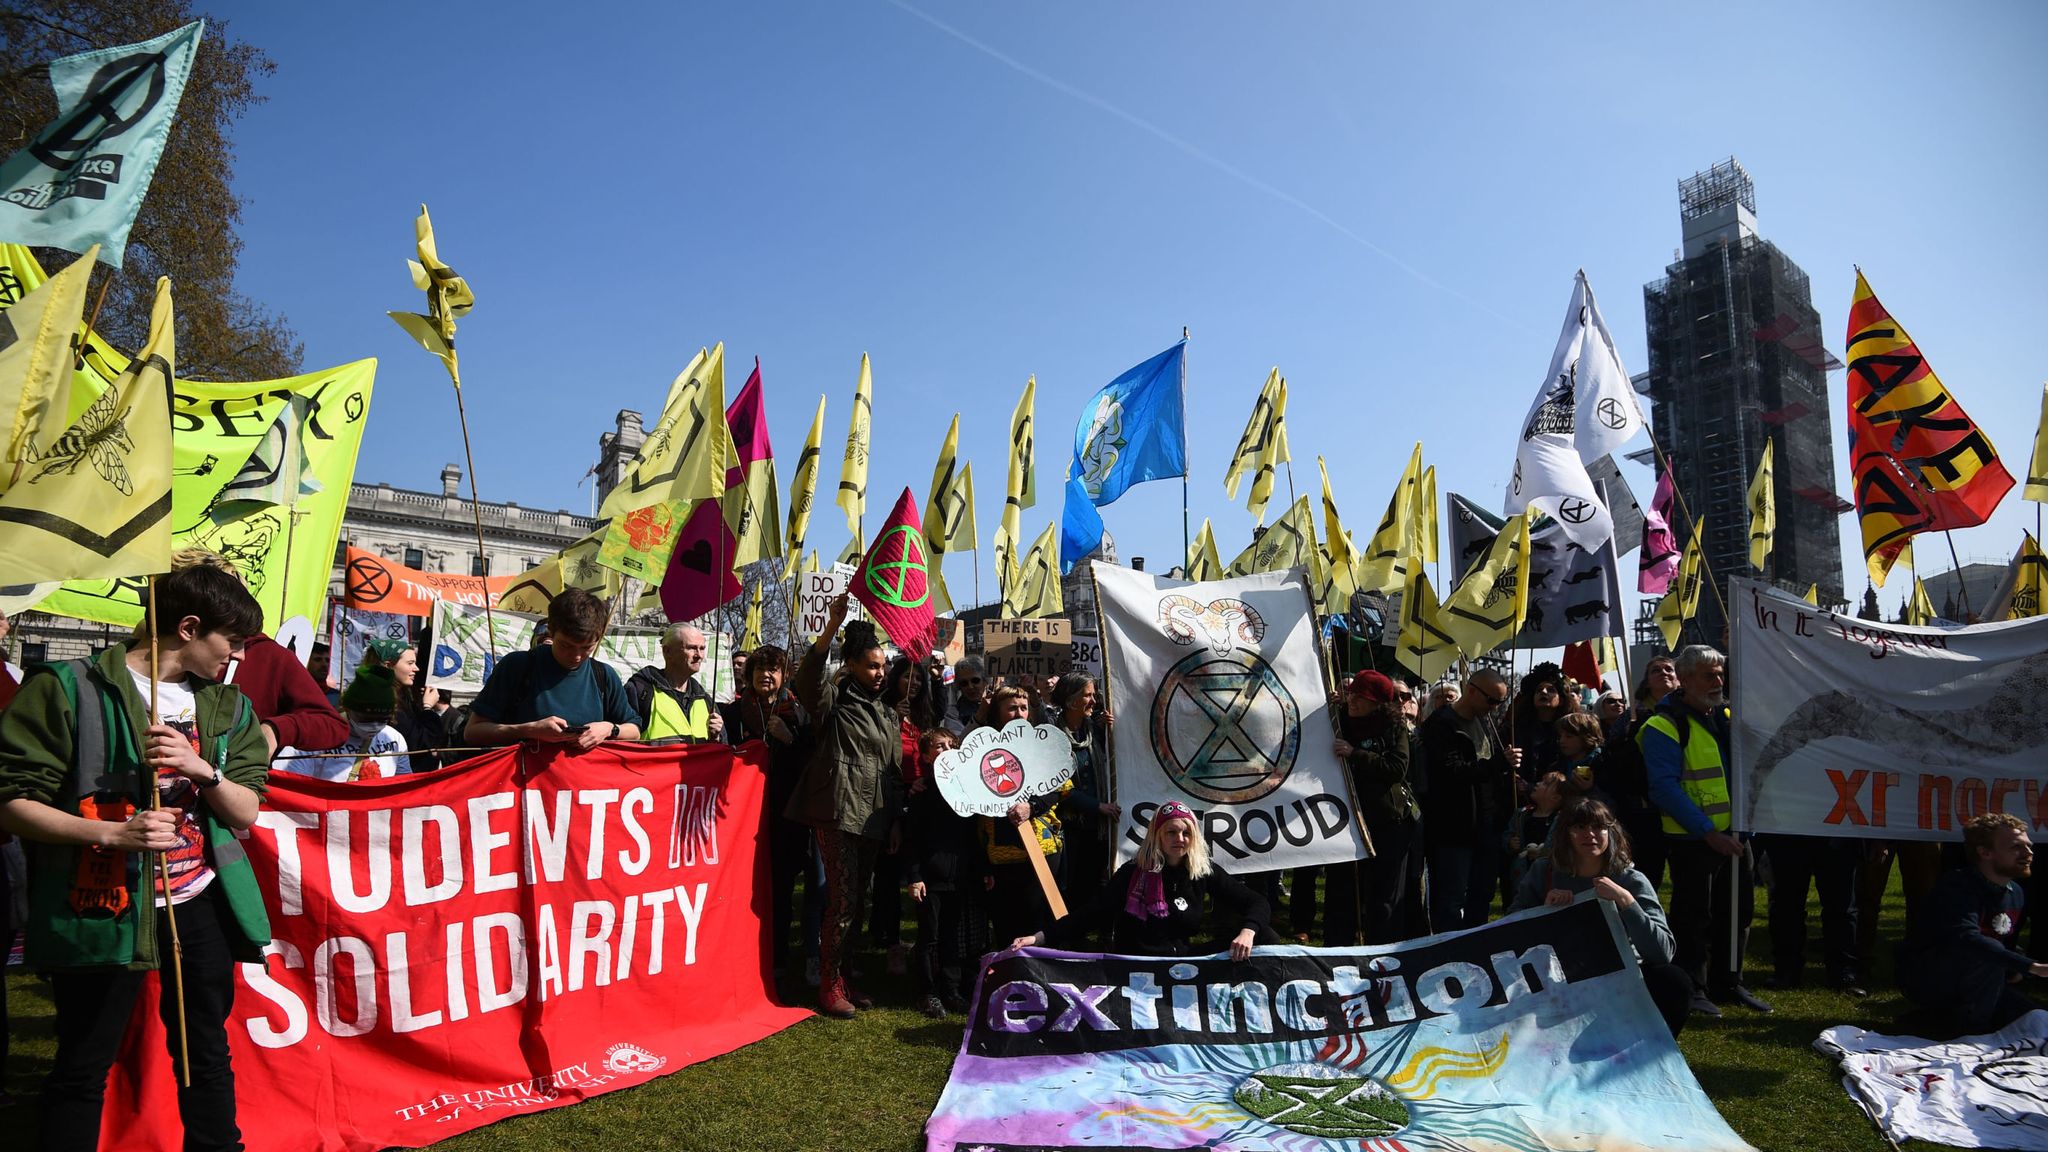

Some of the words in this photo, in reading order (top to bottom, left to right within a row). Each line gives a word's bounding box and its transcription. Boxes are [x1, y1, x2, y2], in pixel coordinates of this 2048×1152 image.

[173, 380, 337, 441] SEX
[400, 579, 442, 602] TINY
[456, 591, 503, 607] HOUS
[426, 575, 486, 591] SUPPORT
[812, 576, 834, 593] DO
[1751, 587, 1780, 632] In
[987, 621, 1040, 634] THERE
[1047, 622, 1060, 636] IS
[1016, 637, 1042, 652] NO
[1071, 641, 1100, 662] BBC
[347, 740, 399, 757] Poution
[938, 757, 955, 780] WE
[957, 731, 986, 764] DON'T
[990, 726, 1026, 743] WANT
[1034, 728, 1048, 740] TO
[954, 801, 978, 814] LIVE
[1015, 786, 1035, 804] THIS
[1038, 768, 1070, 792] CLOUD
[1823, 769, 1899, 827] xr
[1126, 793, 1350, 860] SROUD
[232, 786, 654, 916] TUDENTS
[668, 784, 719, 869] IN
[241, 883, 709, 1049] SOLIDARITY
[987, 943, 1567, 1034] extinction
[605, 1042, 653, 1057] UNIVERSIT
[396, 1093, 459, 1121] THE
[436, 1106, 462, 1123] of
